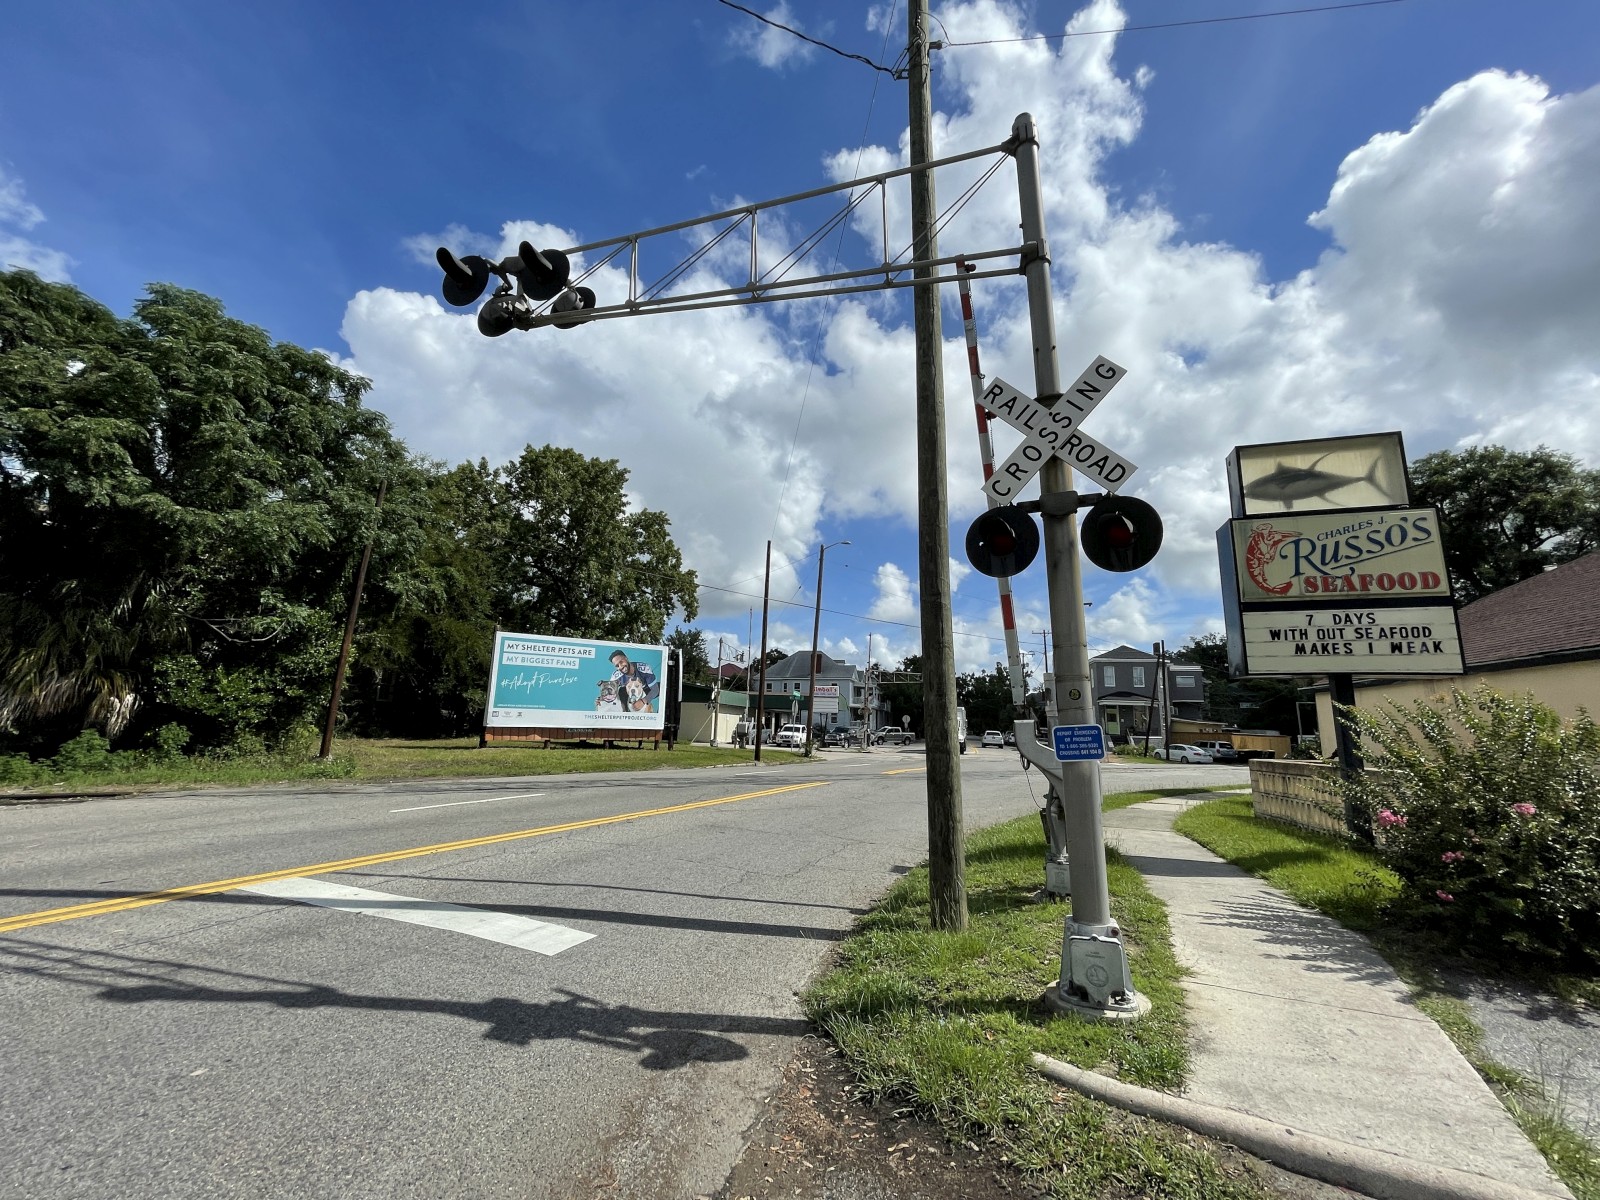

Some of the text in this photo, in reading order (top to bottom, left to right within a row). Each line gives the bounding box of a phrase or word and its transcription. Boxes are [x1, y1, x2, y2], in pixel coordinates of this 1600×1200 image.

[983, 383, 1127, 483] RAIL ROAD
[991, 363, 1117, 497] CROSSING
[1316, 516, 1388, 542] CHARLES J.
[1302, 571, 1442, 594] SEAFOOD
[1305, 612, 1376, 626] 7 DAYS
[1269, 626, 1432, 641] WITH OUT SEAFOOD
[521, 644, 556, 653] SHELTER
[558, 647, 576, 655] PETS
[1294, 642, 1353, 655] MAKES
[1390, 640, 1444, 654] WEAK
[521, 656, 555, 665] BIGGEST
[556, 659, 577, 667] FANS
